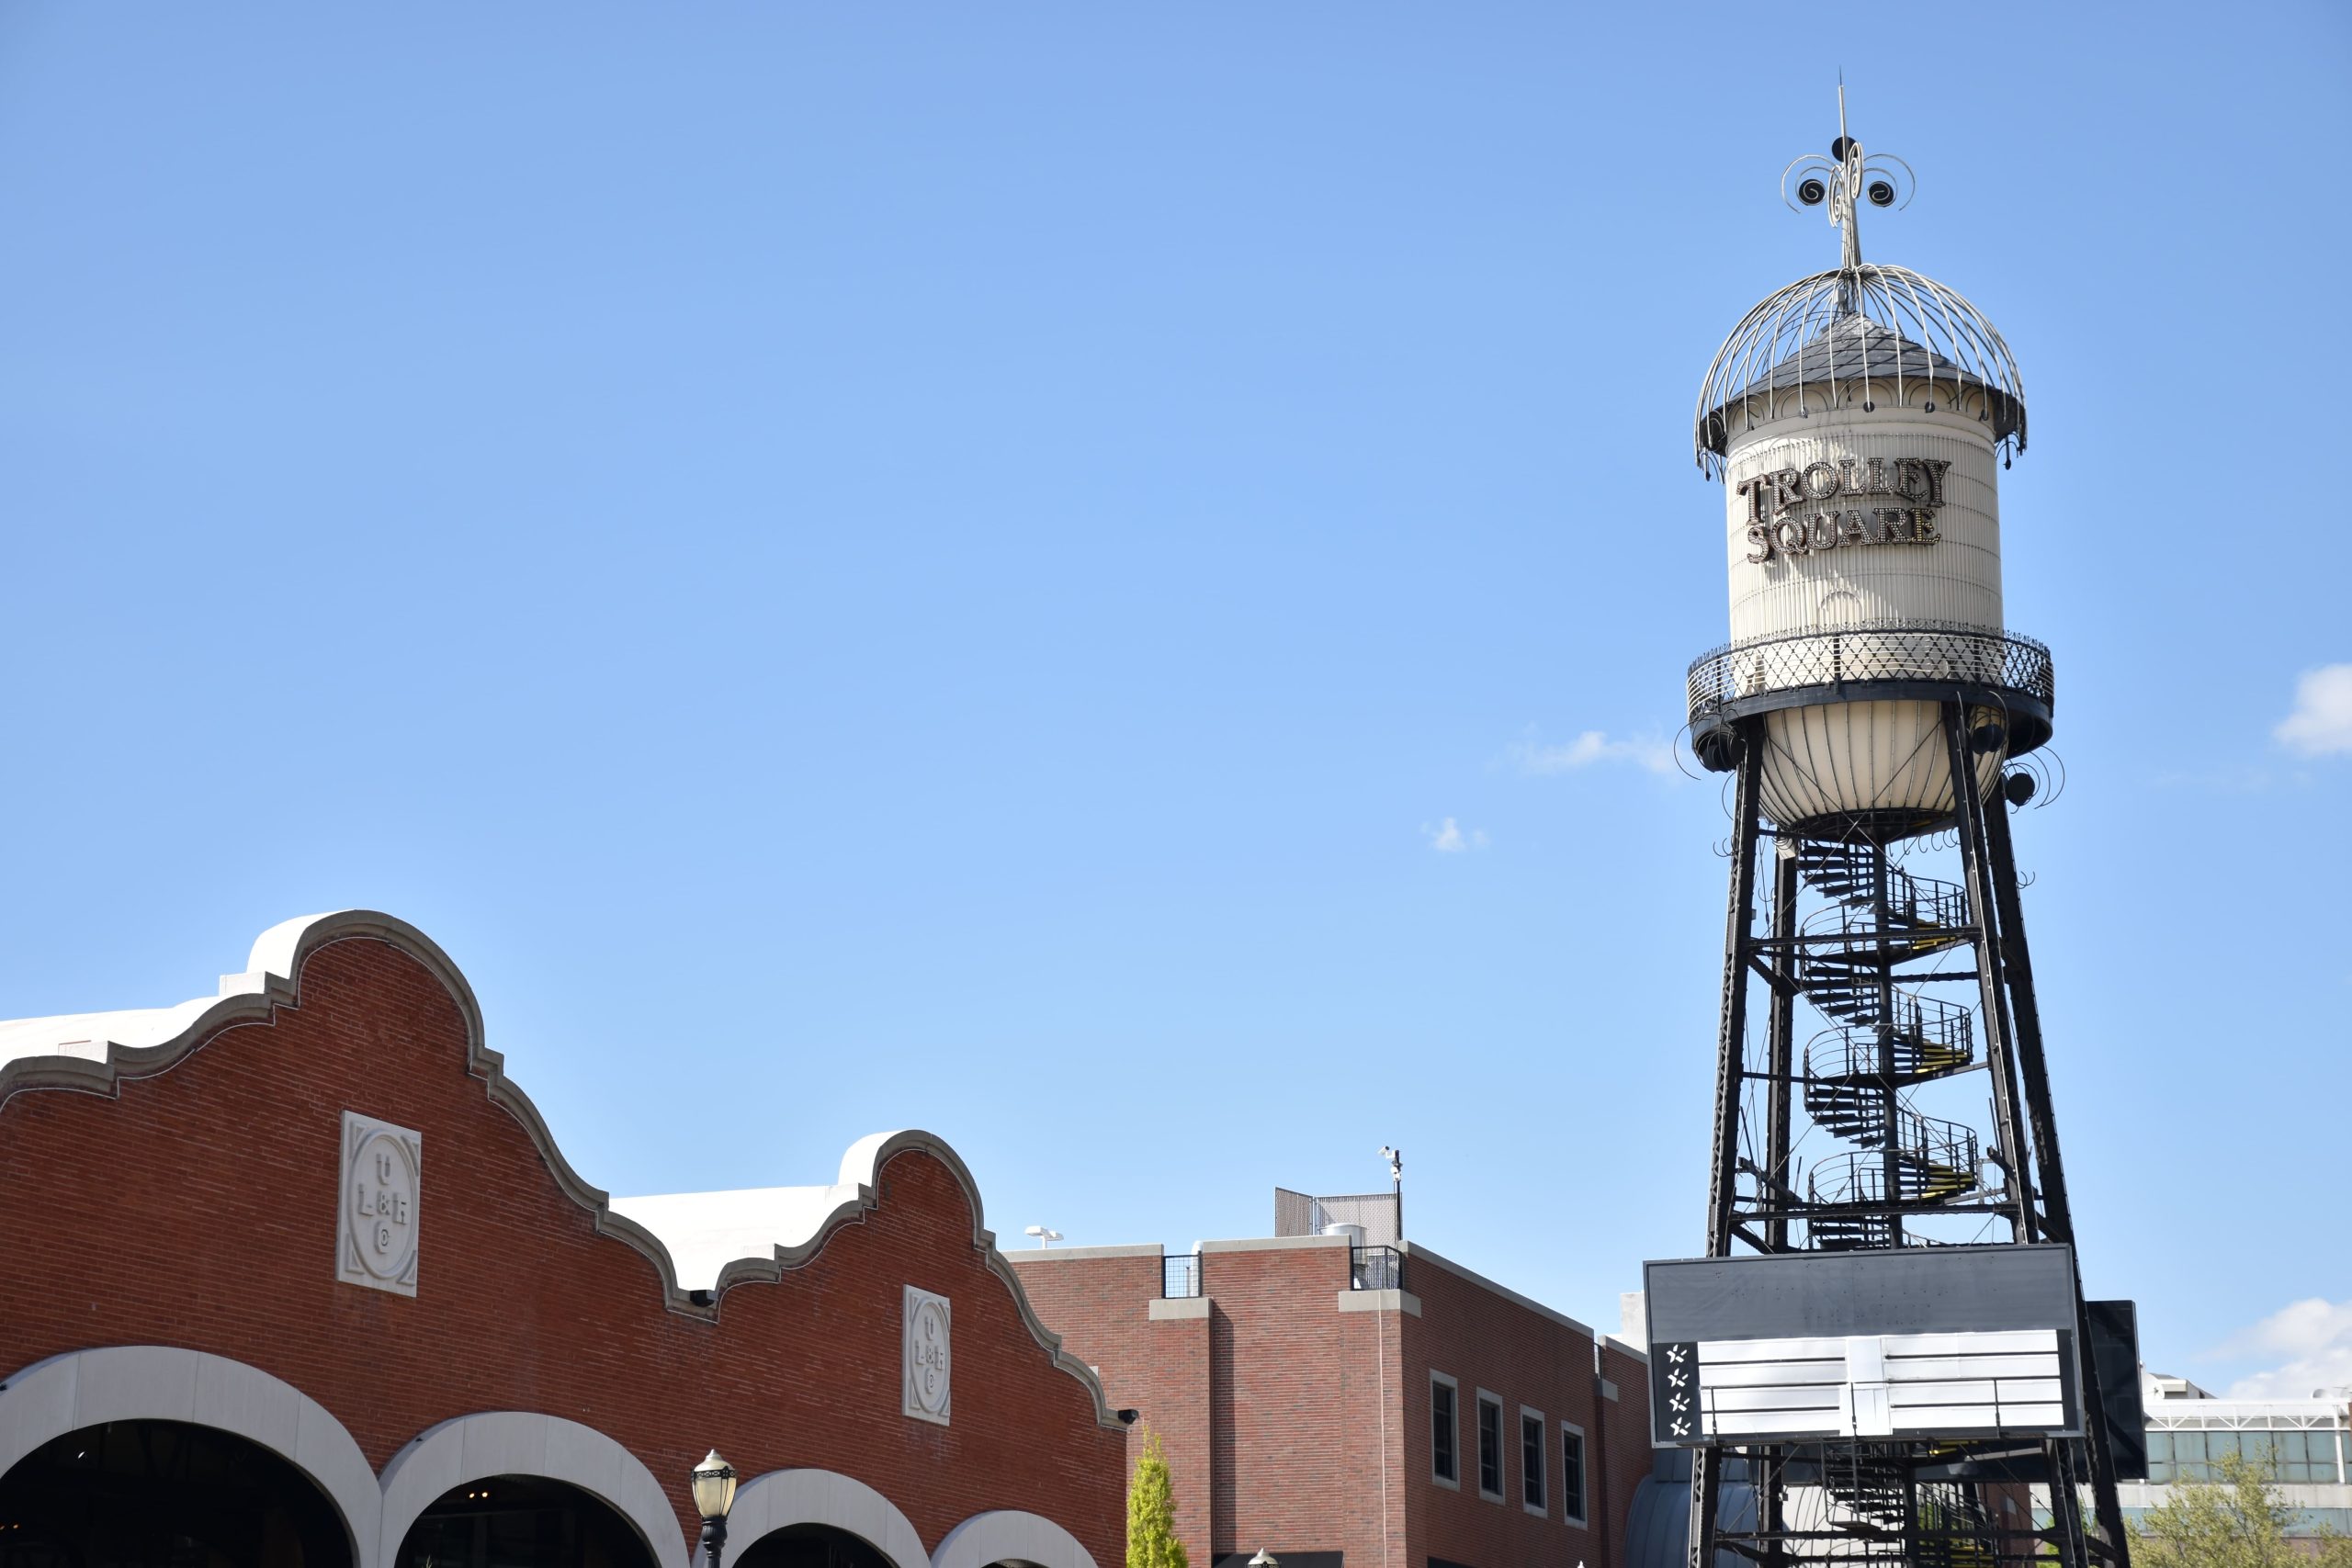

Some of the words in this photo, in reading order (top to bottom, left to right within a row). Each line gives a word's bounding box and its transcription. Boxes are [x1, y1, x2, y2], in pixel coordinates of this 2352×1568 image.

[1736, 457, 1951, 525] TROLLEY
[1747, 507, 1942, 564] SQUARE
[376, 1153, 391, 1186] U
[924, 1316, 935, 1341] U
